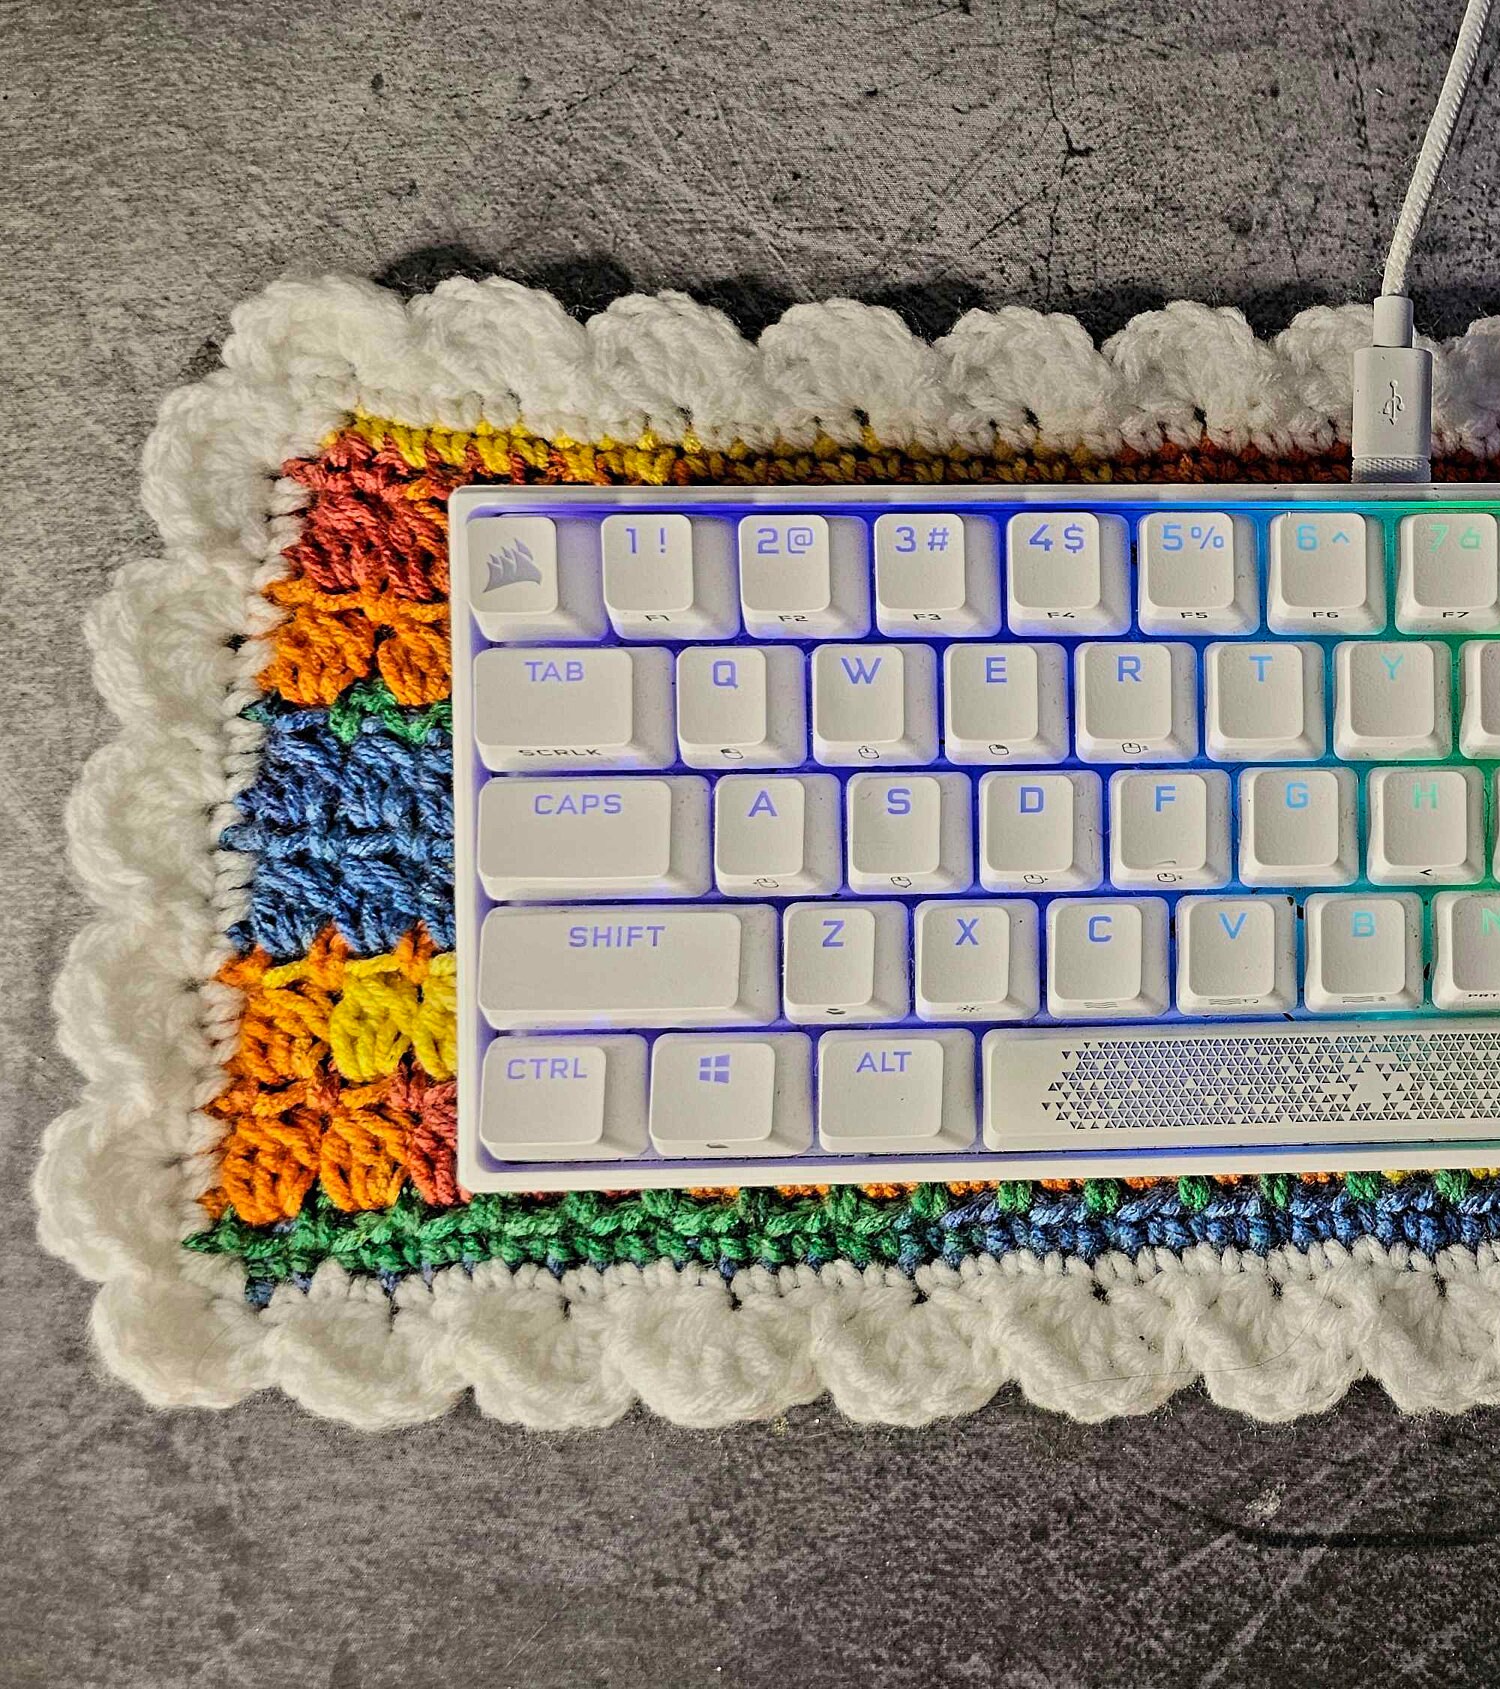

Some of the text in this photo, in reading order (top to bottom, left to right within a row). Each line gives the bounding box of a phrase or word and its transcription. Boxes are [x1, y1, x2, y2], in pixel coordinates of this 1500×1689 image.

[645, 614, 671, 623] F1
[777, 614, 809, 623] F2
[912, 612, 943, 622] F3
[1046, 611, 1076, 620] F4
[1179, 611, 1208, 620] F5
[1311, 611, 1339, 619] F6
[1441, 611, 1470, 619] F7
[524, 660, 585, 683] TAB
[712, 660, 740, 690] Q
[841, 656, 883, 685] W
[985, 656, 1009, 684] E
[1117, 655, 1142, 682] R
[1249, 655, 1273, 682] T
[1379, 654, 1404, 682] Y
[517, 748, 603, 757] SCRLK
[534, 793, 623, 815] CAPS
[747, 790, 778, 818] A
[887, 788, 913, 815] S
[1020, 786, 1045, 814] D
[1155, 786, 1177, 812] F
[1285, 782, 1310, 810] G
[1412, 781, 1439, 809] H
[568, 925, 666, 948] SHIFT
[822, 920, 845, 948] Z
[954, 918, 981, 946] X
[1088, 916, 1112, 943] C
[1219, 912, 1247, 940] V
[1352, 911, 1376, 938] B
[507, 1057, 588, 1080] CTRL
[856, 1051, 912, 1073] ALT
